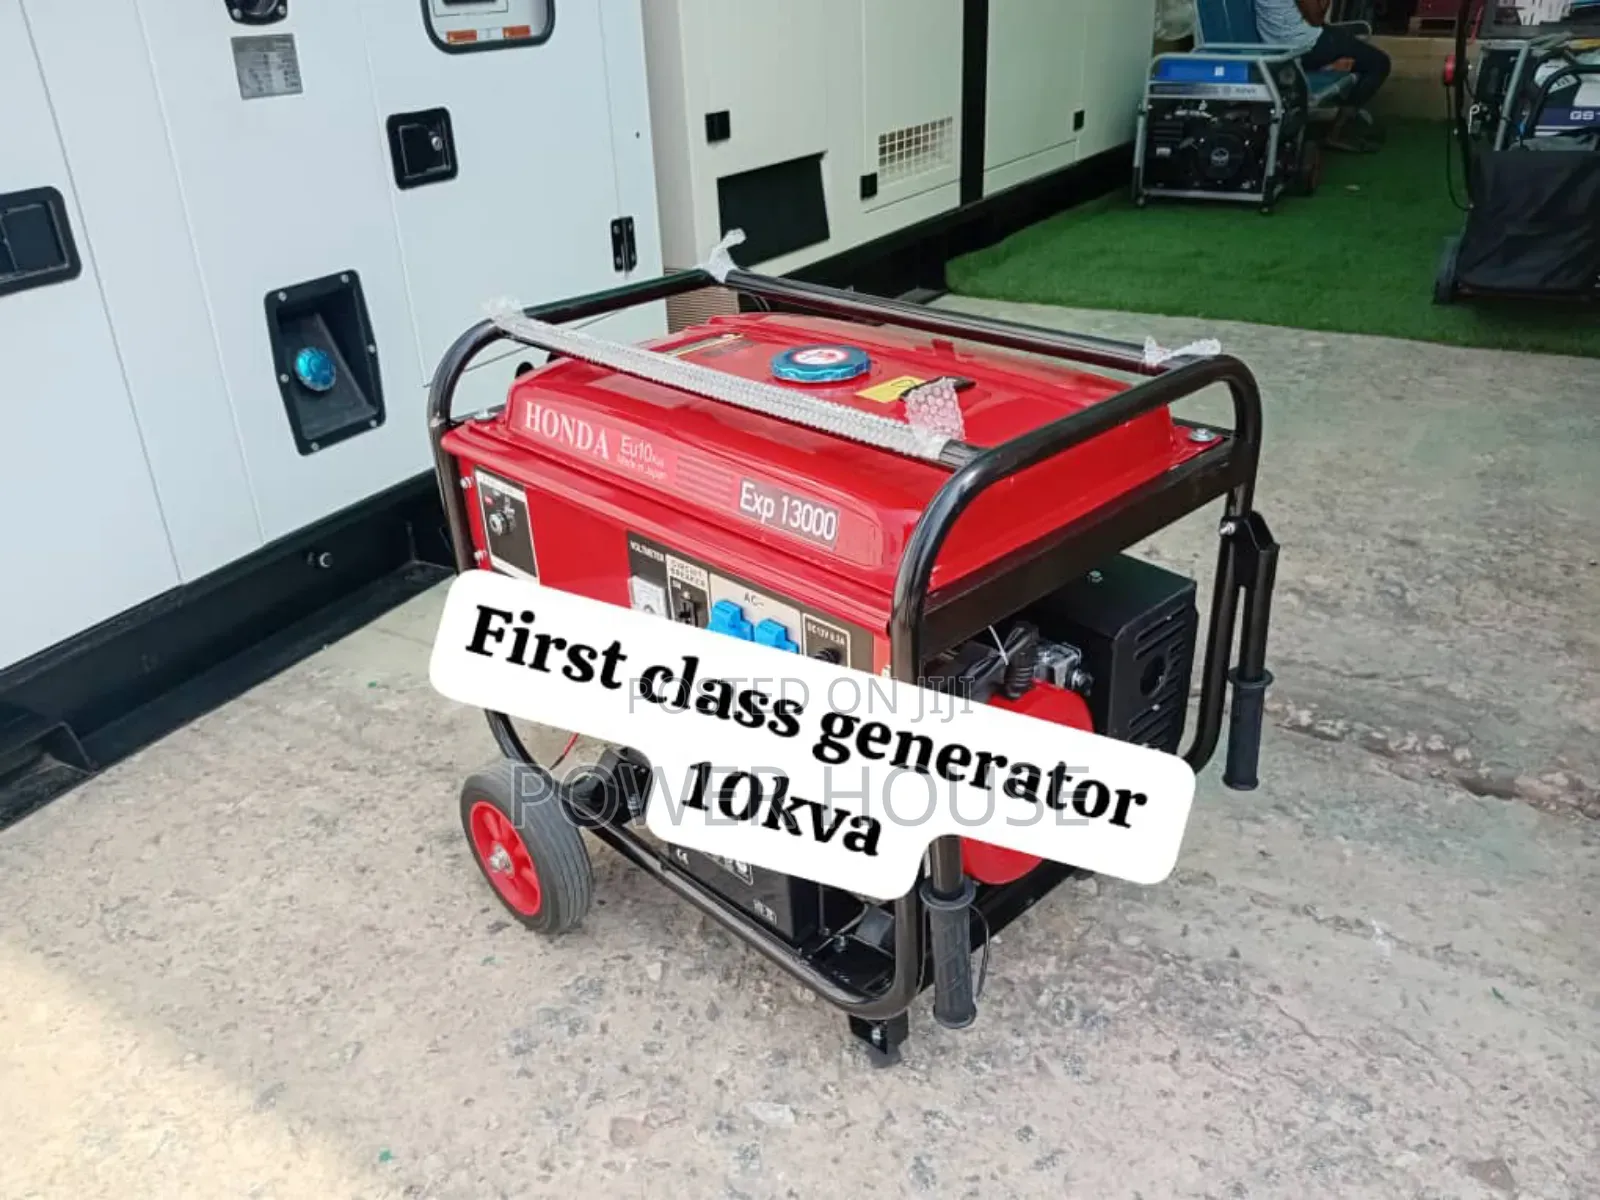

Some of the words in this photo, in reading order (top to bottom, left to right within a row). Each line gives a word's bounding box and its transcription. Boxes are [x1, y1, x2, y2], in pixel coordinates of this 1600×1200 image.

[1570, 110, 1600, 120] GS
[525, 401, 609, 460] HONDA
[740, 481, 775, 525] Exp
[781, 495, 836, 541] 13000
